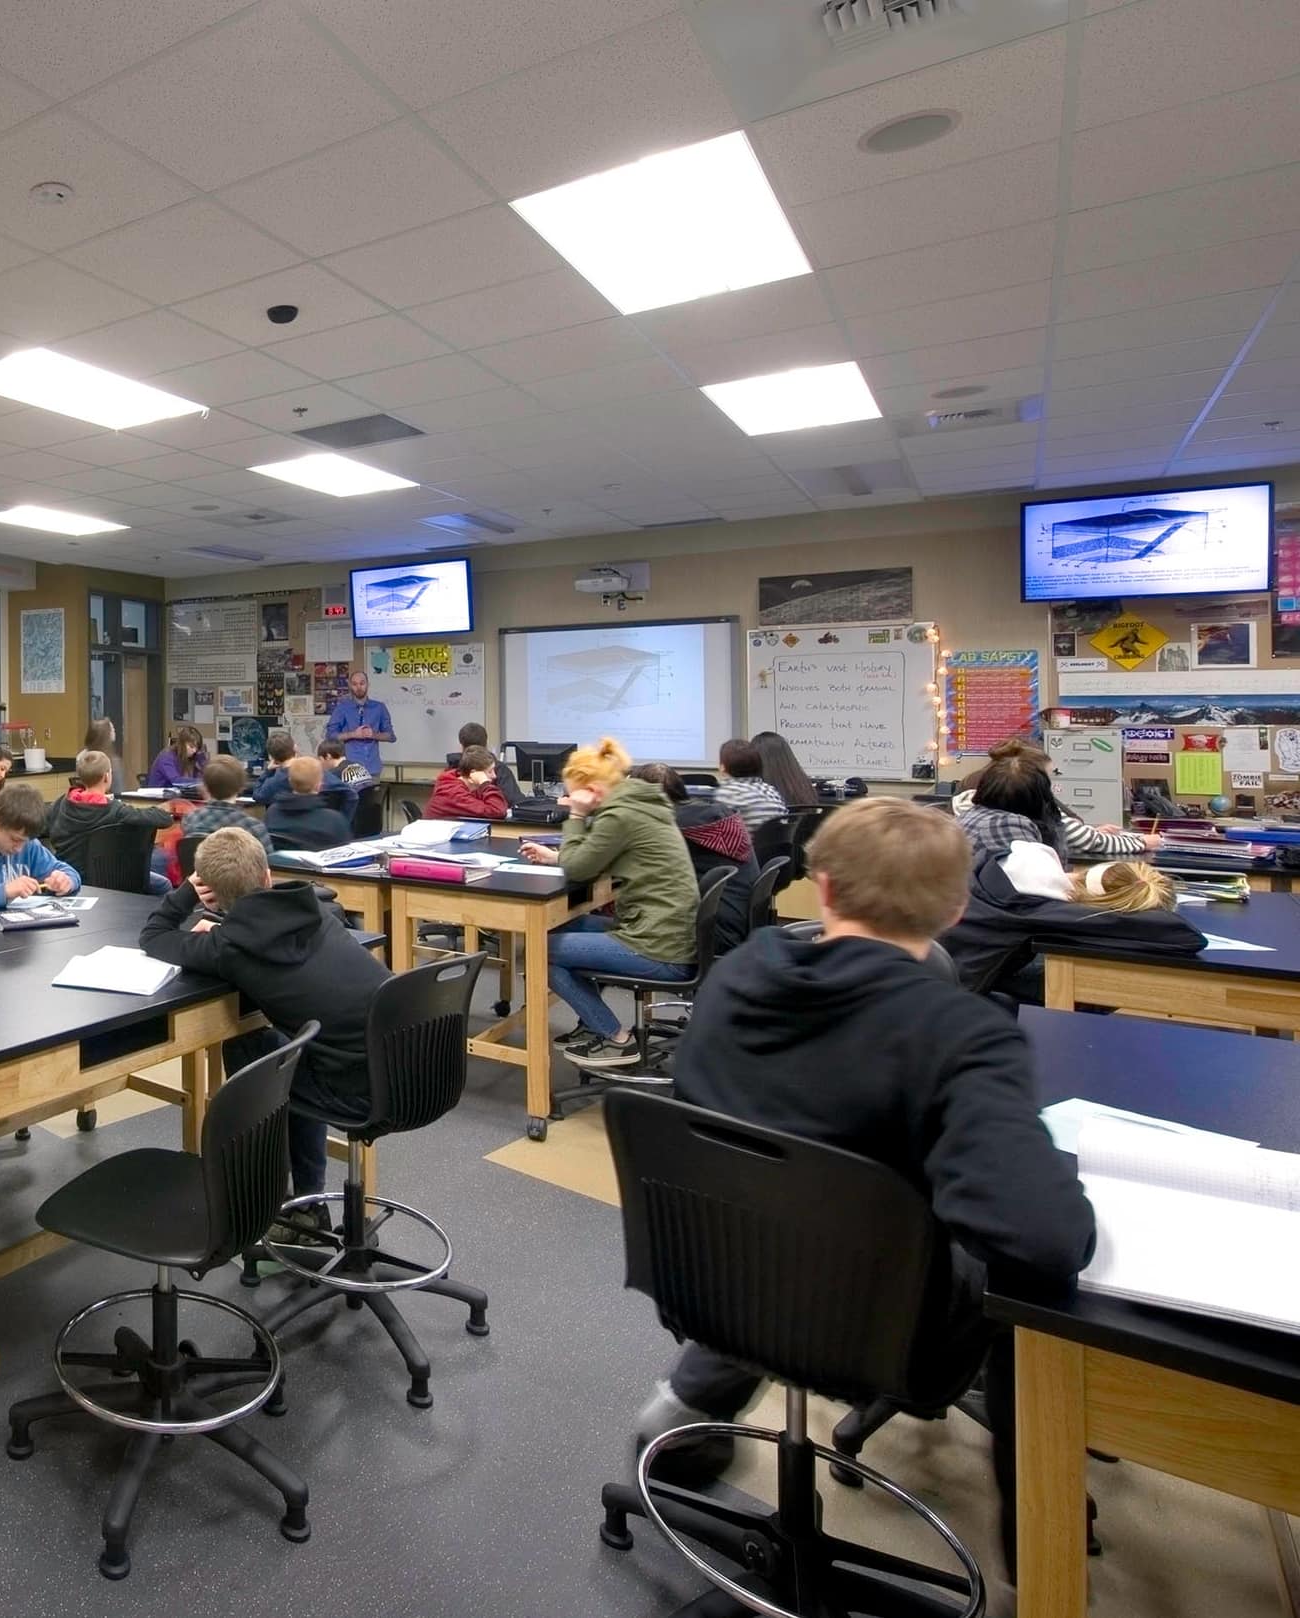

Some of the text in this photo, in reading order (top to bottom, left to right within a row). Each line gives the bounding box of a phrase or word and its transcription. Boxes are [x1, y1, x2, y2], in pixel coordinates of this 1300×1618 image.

[618, 599, 626, 611] E
[1113, 621, 1144, 629] BIGFOOT
[398, 646, 445, 660] EARTH
[982, 651, 1033, 662] SAFETY
[394, 661, 448, 675] SCIENCE
